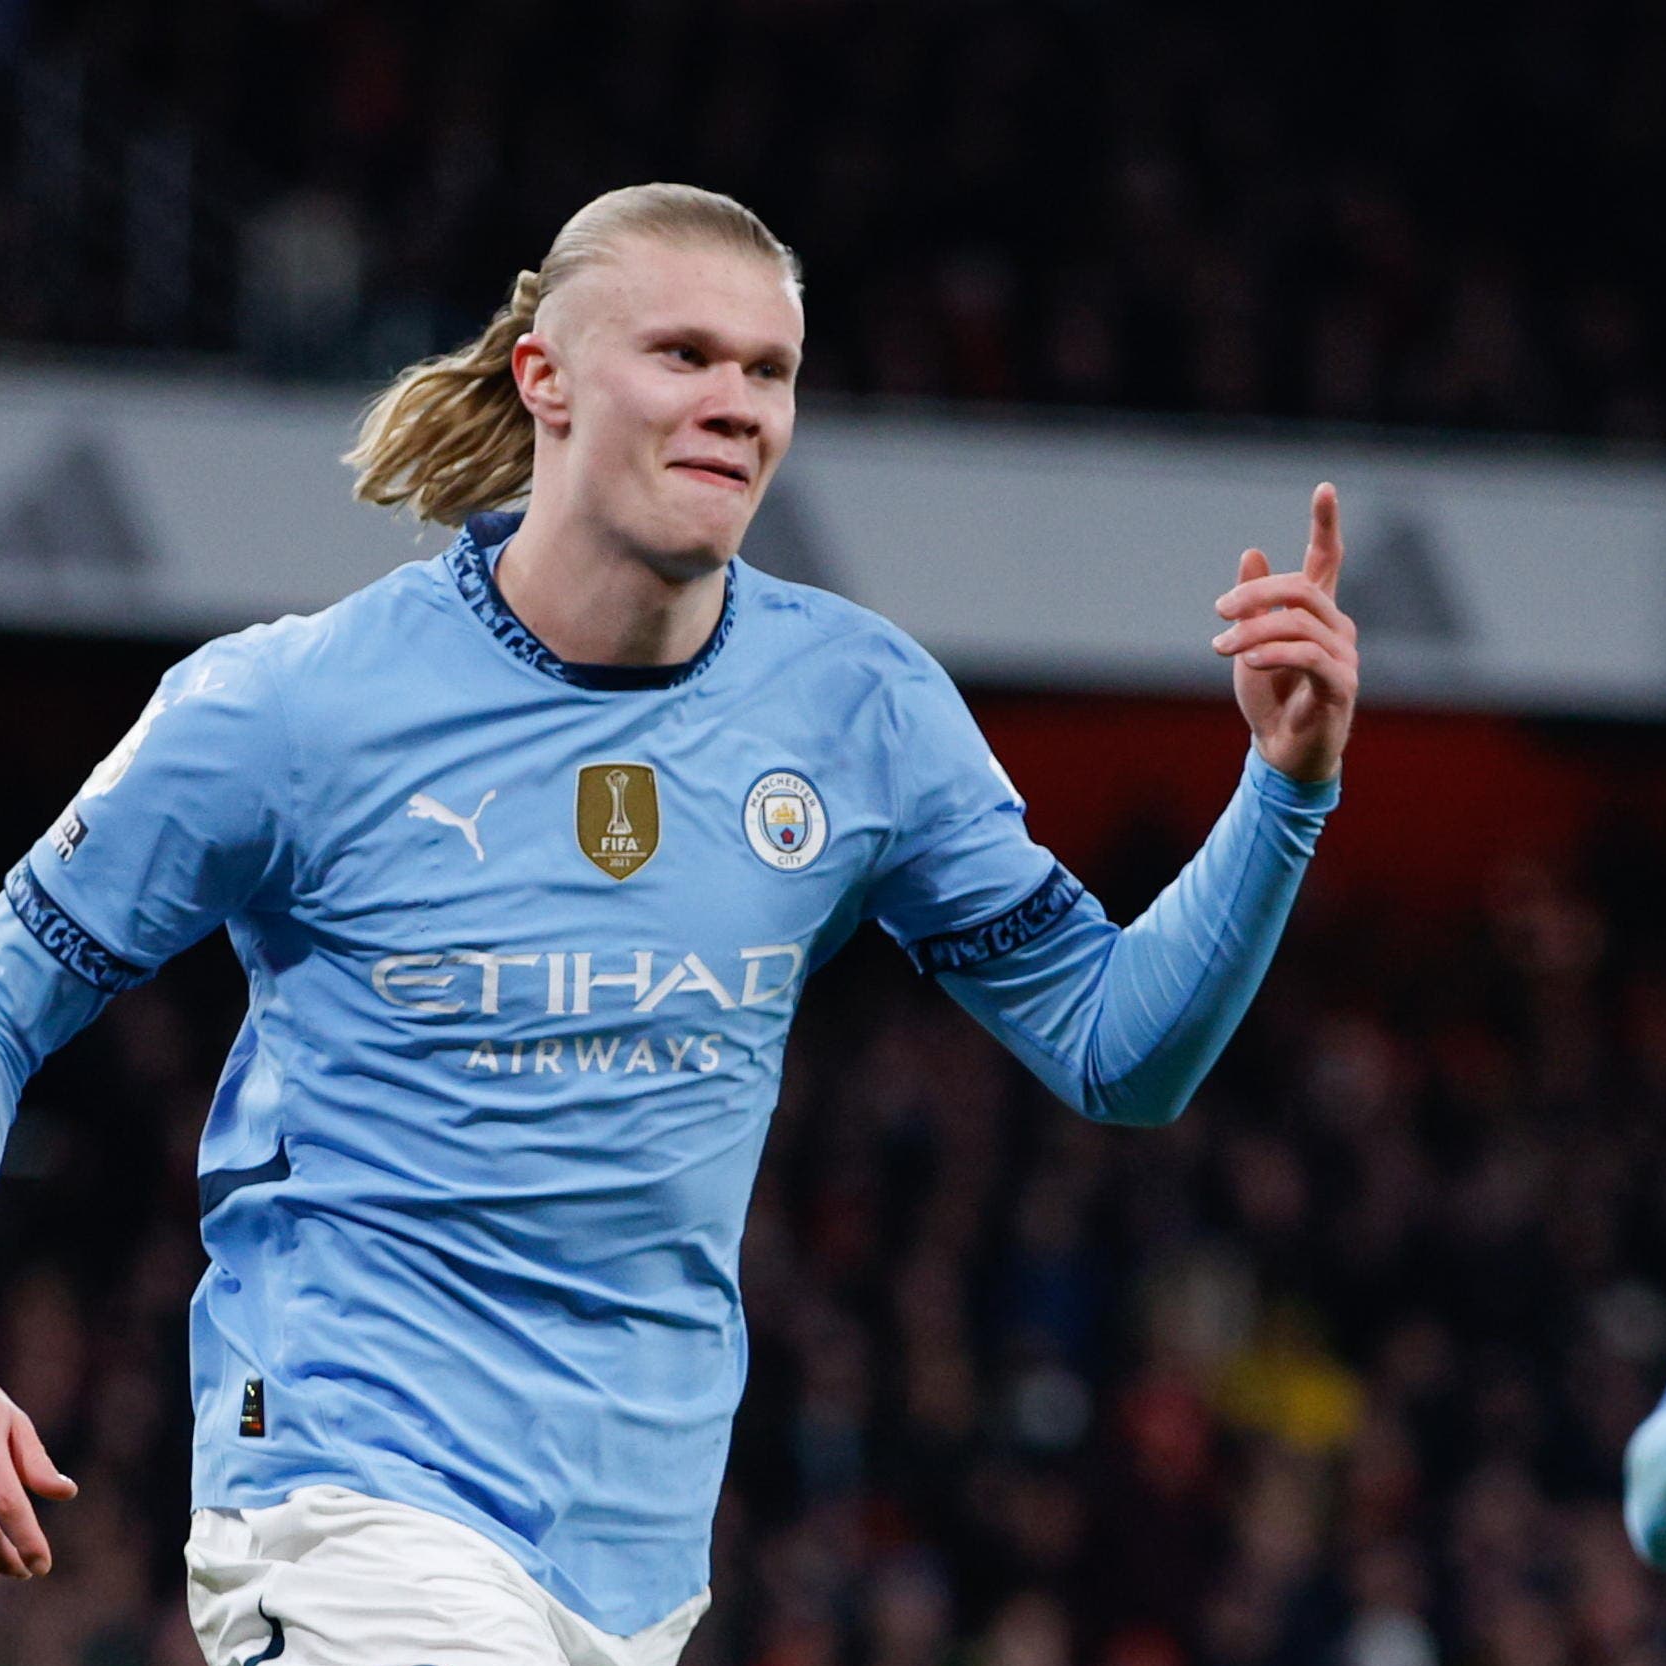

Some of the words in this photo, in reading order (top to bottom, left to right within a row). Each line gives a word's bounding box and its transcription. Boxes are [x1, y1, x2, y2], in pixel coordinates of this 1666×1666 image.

[750, 776, 817, 808] MANCHESTER
[600, 836, 638, 851] FIFA
[777, 855, 803, 866] CITY
[370, 942, 804, 1016] ETIHAD
[465, 1033, 724, 1075] AIRWAYS
